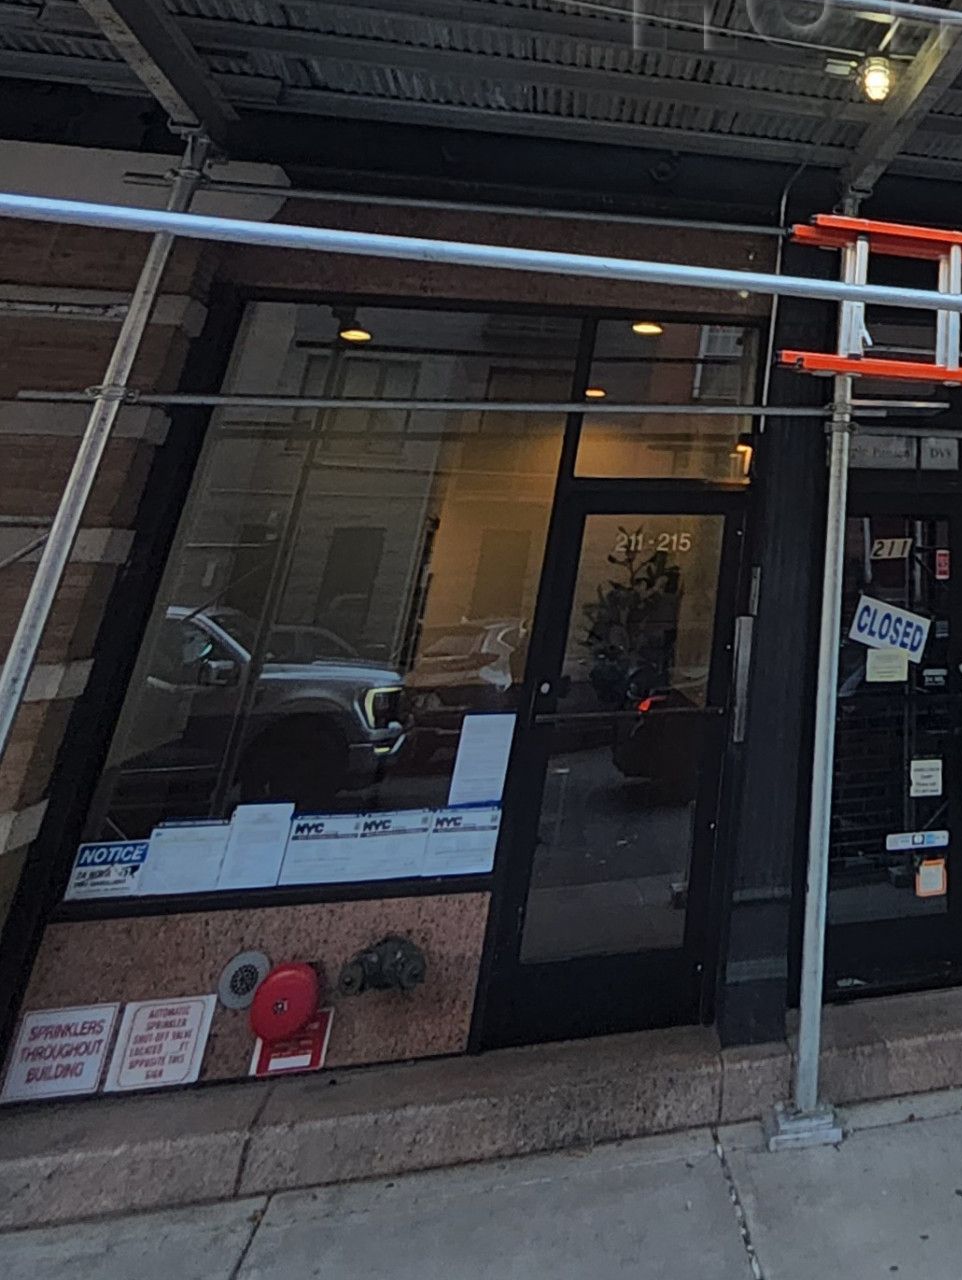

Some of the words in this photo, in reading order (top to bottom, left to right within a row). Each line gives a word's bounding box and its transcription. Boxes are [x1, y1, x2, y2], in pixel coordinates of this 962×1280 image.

[873, 540, 908, 558] 211
[856, 604, 924, 652] CLOSED
[294, 822, 325, 834] NYC
[363, 819, 392, 832] NYC
[435, 816, 463, 828] NYC
[79, 844, 147, 865] NOTICE
[29, 1020, 104, 1041] SPRINKLERS
[22, 1040, 103, 1062] THROUGHOUT
[26, 1063, 84, 1084] BUILDING
